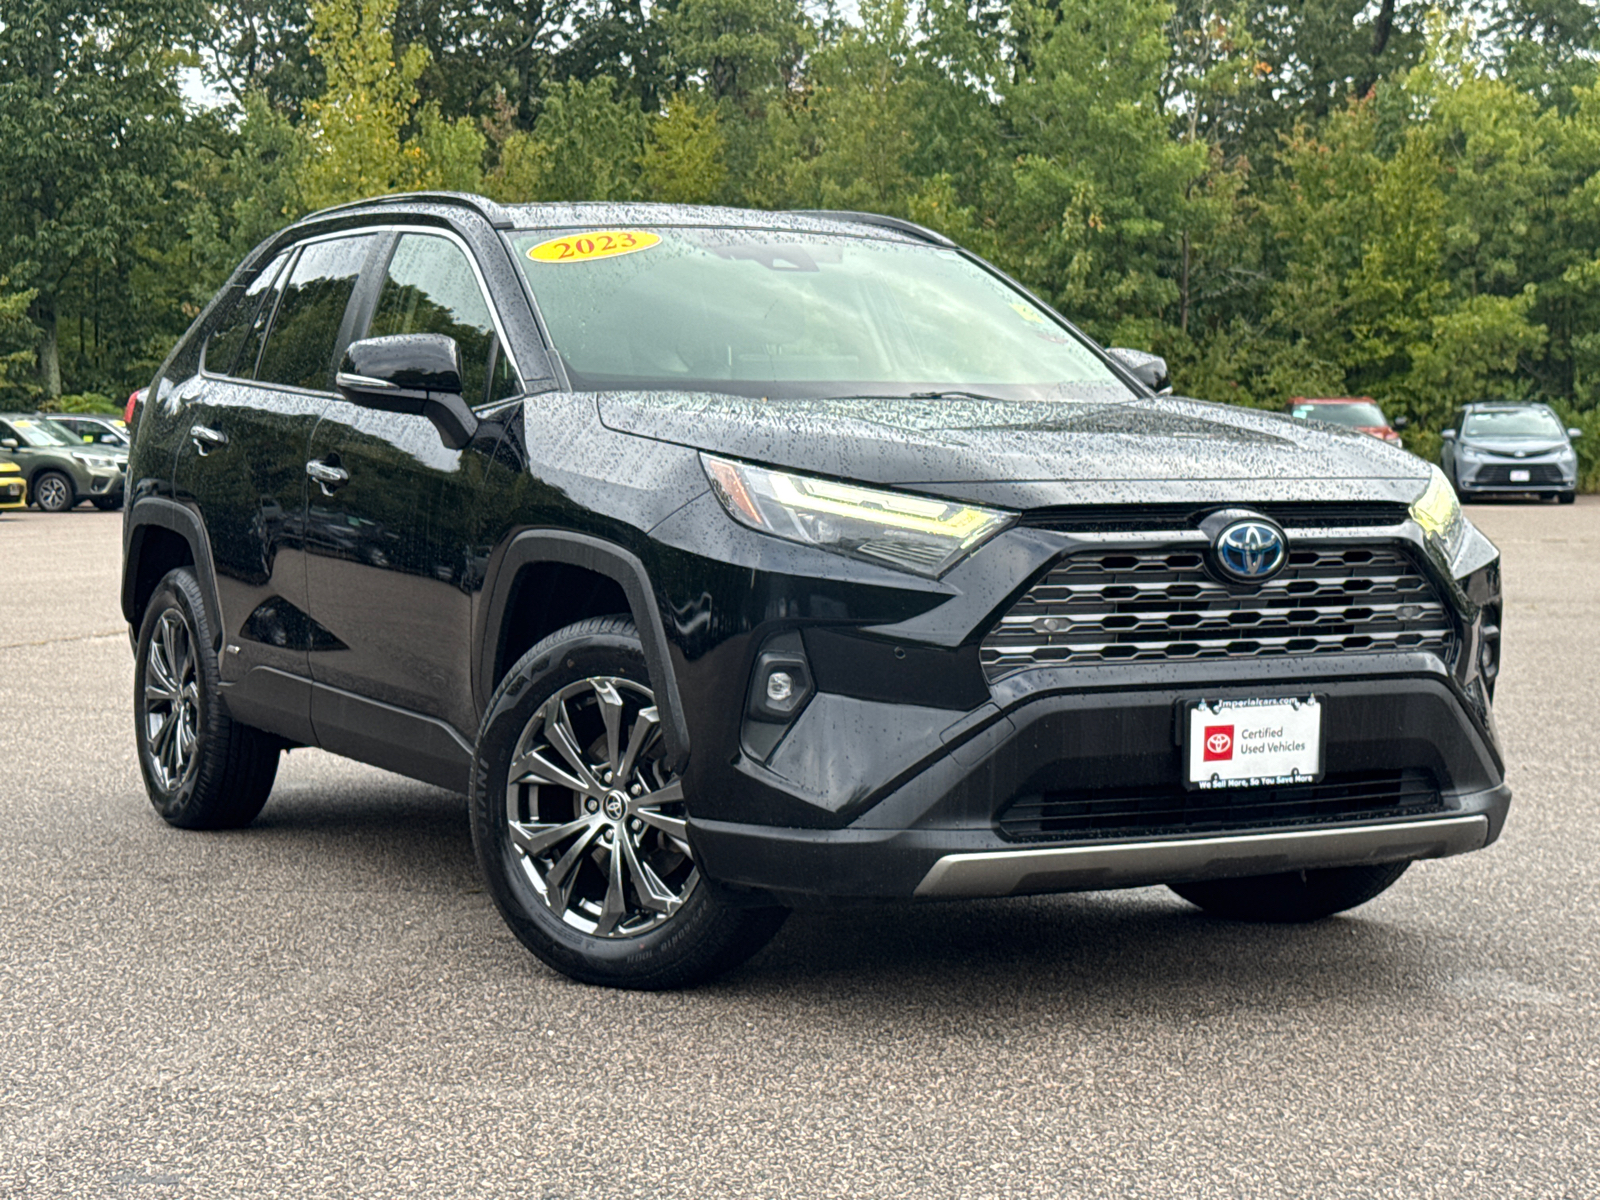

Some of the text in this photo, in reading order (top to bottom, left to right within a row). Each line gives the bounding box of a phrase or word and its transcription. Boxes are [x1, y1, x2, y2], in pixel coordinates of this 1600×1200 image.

[554, 233, 637, 259] 2023
[1241, 726, 1284, 740] Certified
[1240, 740, 1306, 755] Used Vehicles
[1199, 781, 1211, 789] We
[1213, 779, 1226, 788] Sell
[1261, 776, 1275, 785] You
